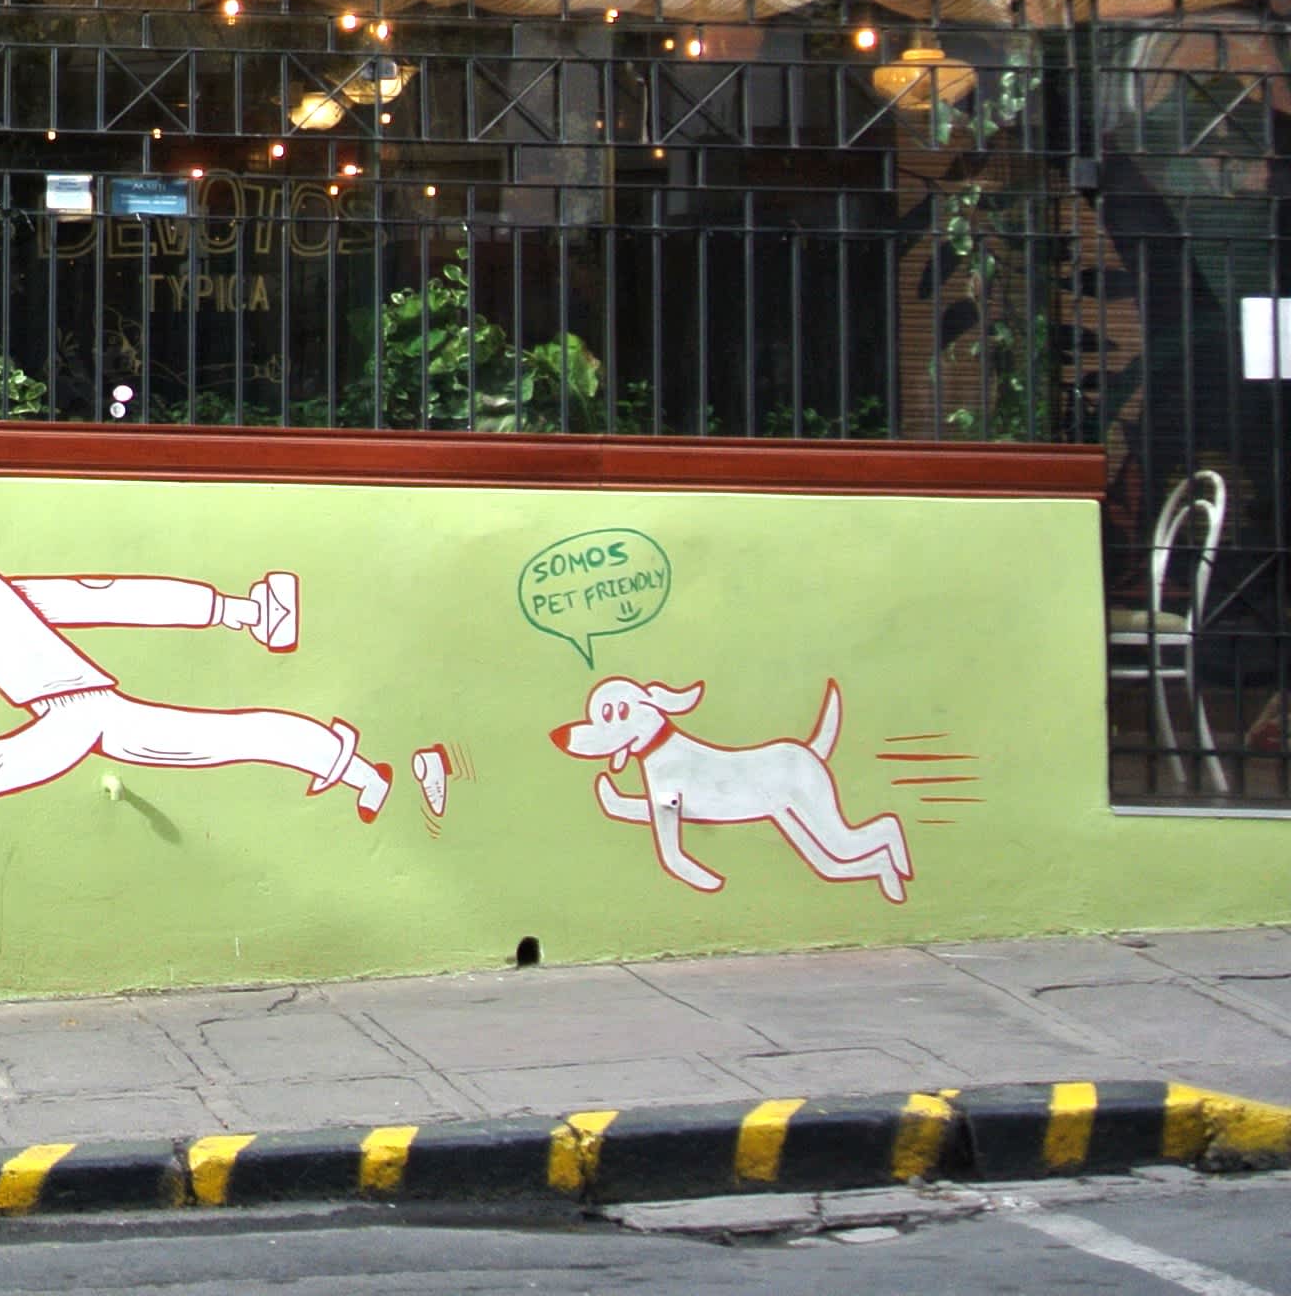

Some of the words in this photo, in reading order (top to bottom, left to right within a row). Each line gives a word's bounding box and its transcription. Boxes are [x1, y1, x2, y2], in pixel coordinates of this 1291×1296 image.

[141, 273, 271, 313] TYPICA
[532, 542, 630, 583] SOMOS
[532, 590, 578, 616] PET
[584, 568, 666, 610] FRIENDLY
